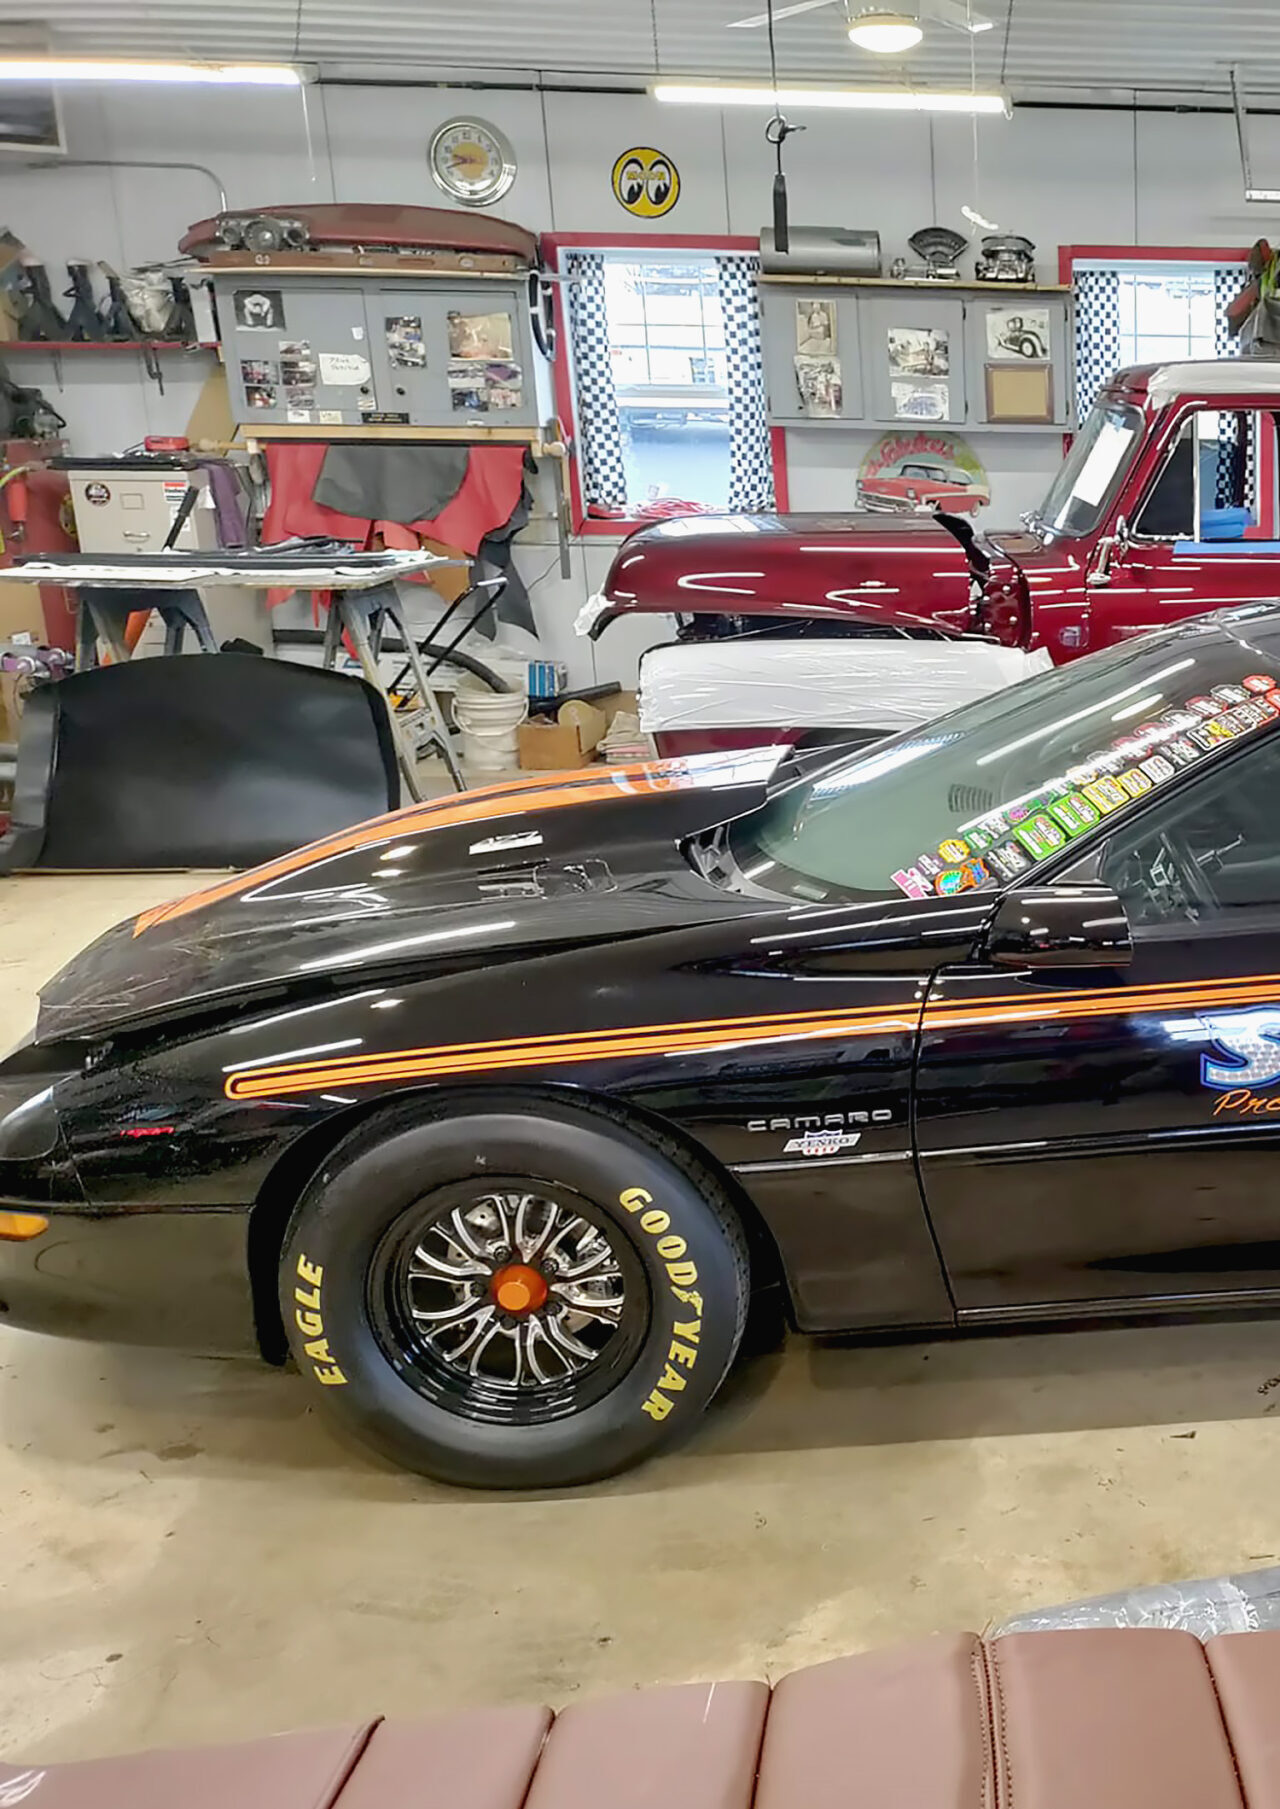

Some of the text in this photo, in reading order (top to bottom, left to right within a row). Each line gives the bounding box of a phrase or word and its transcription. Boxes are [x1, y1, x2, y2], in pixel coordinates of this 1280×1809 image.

[747, 1108, 893, 1132] CAMARO
[295, 1253, 349, 1386] EAGLE
[619, 1187, 703, 1422] GOODYEAR
